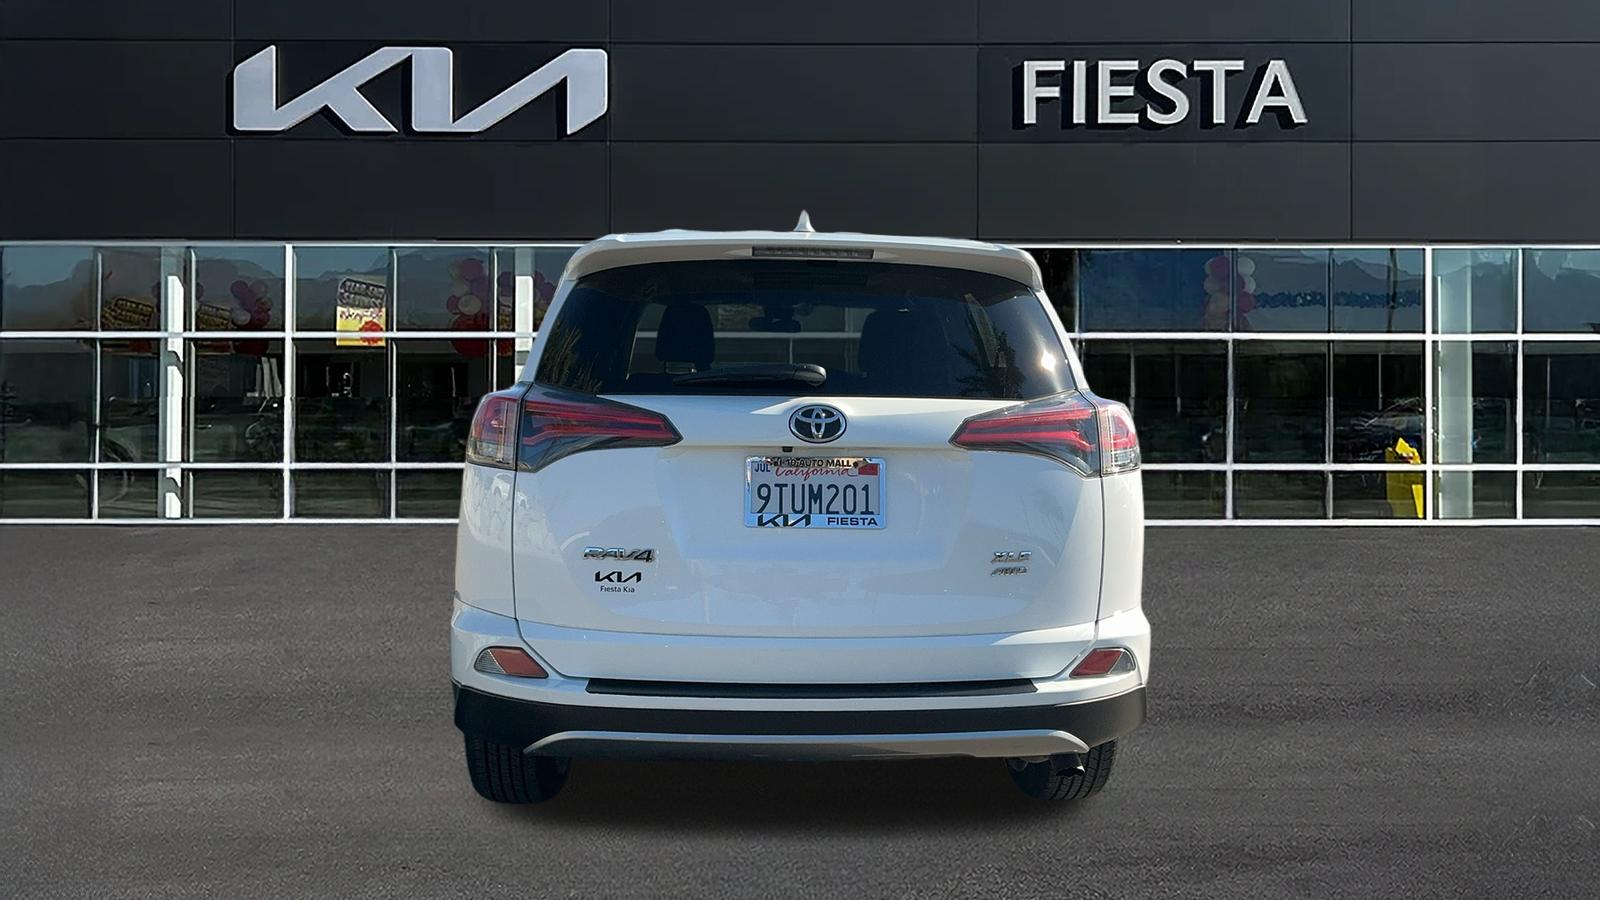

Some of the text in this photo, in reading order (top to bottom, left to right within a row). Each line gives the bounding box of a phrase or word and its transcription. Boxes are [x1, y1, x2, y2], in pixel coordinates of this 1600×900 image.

[234, 45, 608, 135] KIA
[1023, 59, 1308, 125] FIESTA
[754, 463, 771, 472] JUL
[798, 459, 824, 468] AUTO
[826, 459, 852, 468] MALL
[756, 483, 875, 515] 9TUM201
[757, 514, 811, 527] KIA
[827, 517, 878, 526] FIESTA
[583, 546, 654, 562] RAV4
[594, 571, 642, 583] KIA
[600, 585, 621, 593] Fiesta
